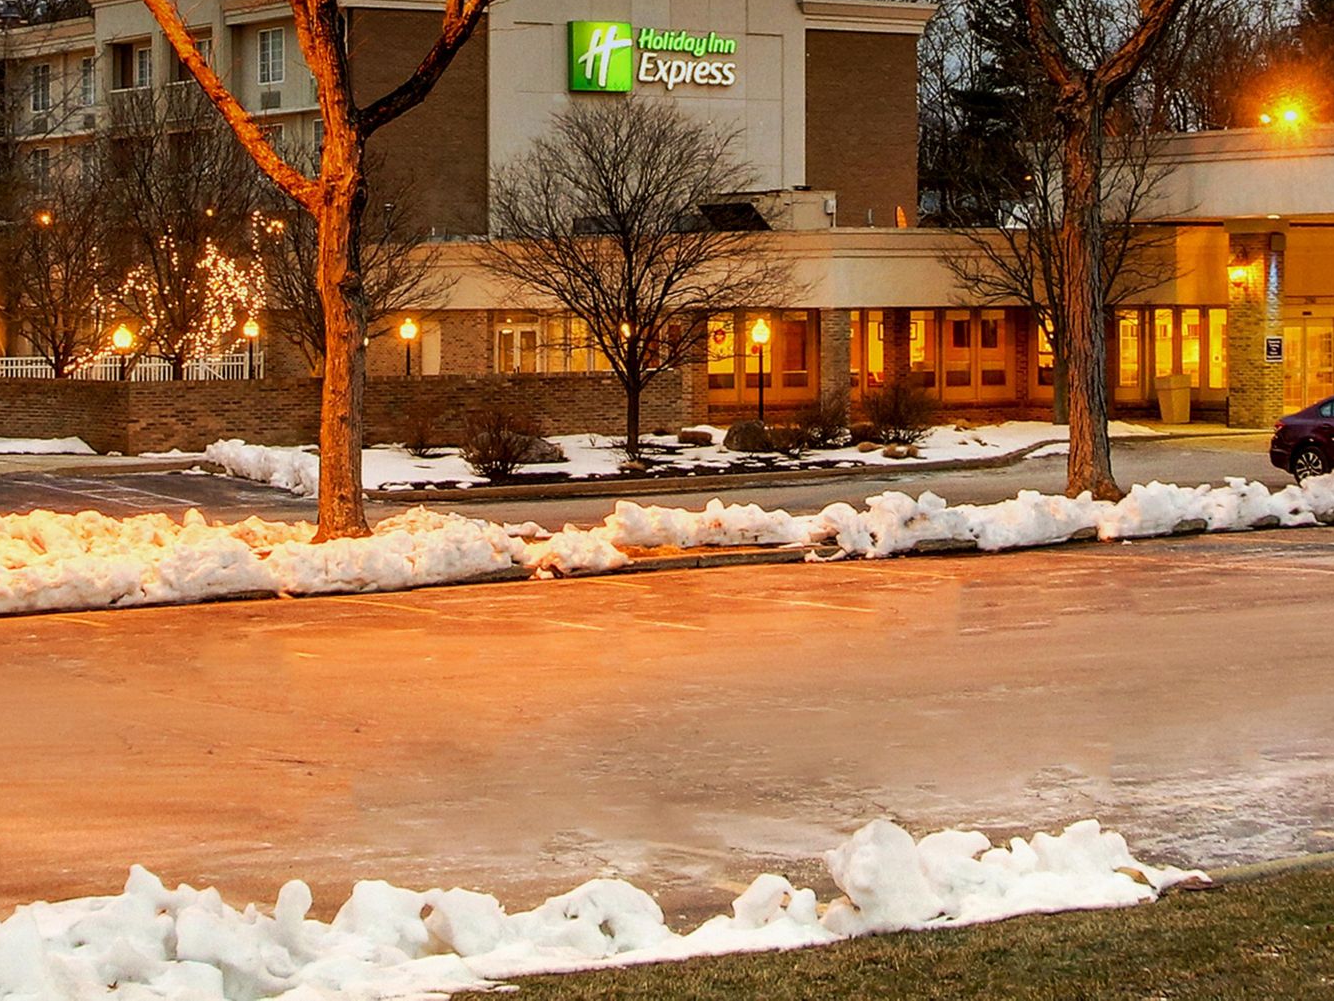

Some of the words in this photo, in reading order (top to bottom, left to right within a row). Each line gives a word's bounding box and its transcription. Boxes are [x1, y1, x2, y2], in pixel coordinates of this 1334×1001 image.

[578, 25, 632, 87] H
[638, 28, 707, 57] Holiday
[708, 31, 736, 53] Inn
[638, 52, 736, 90] Express
